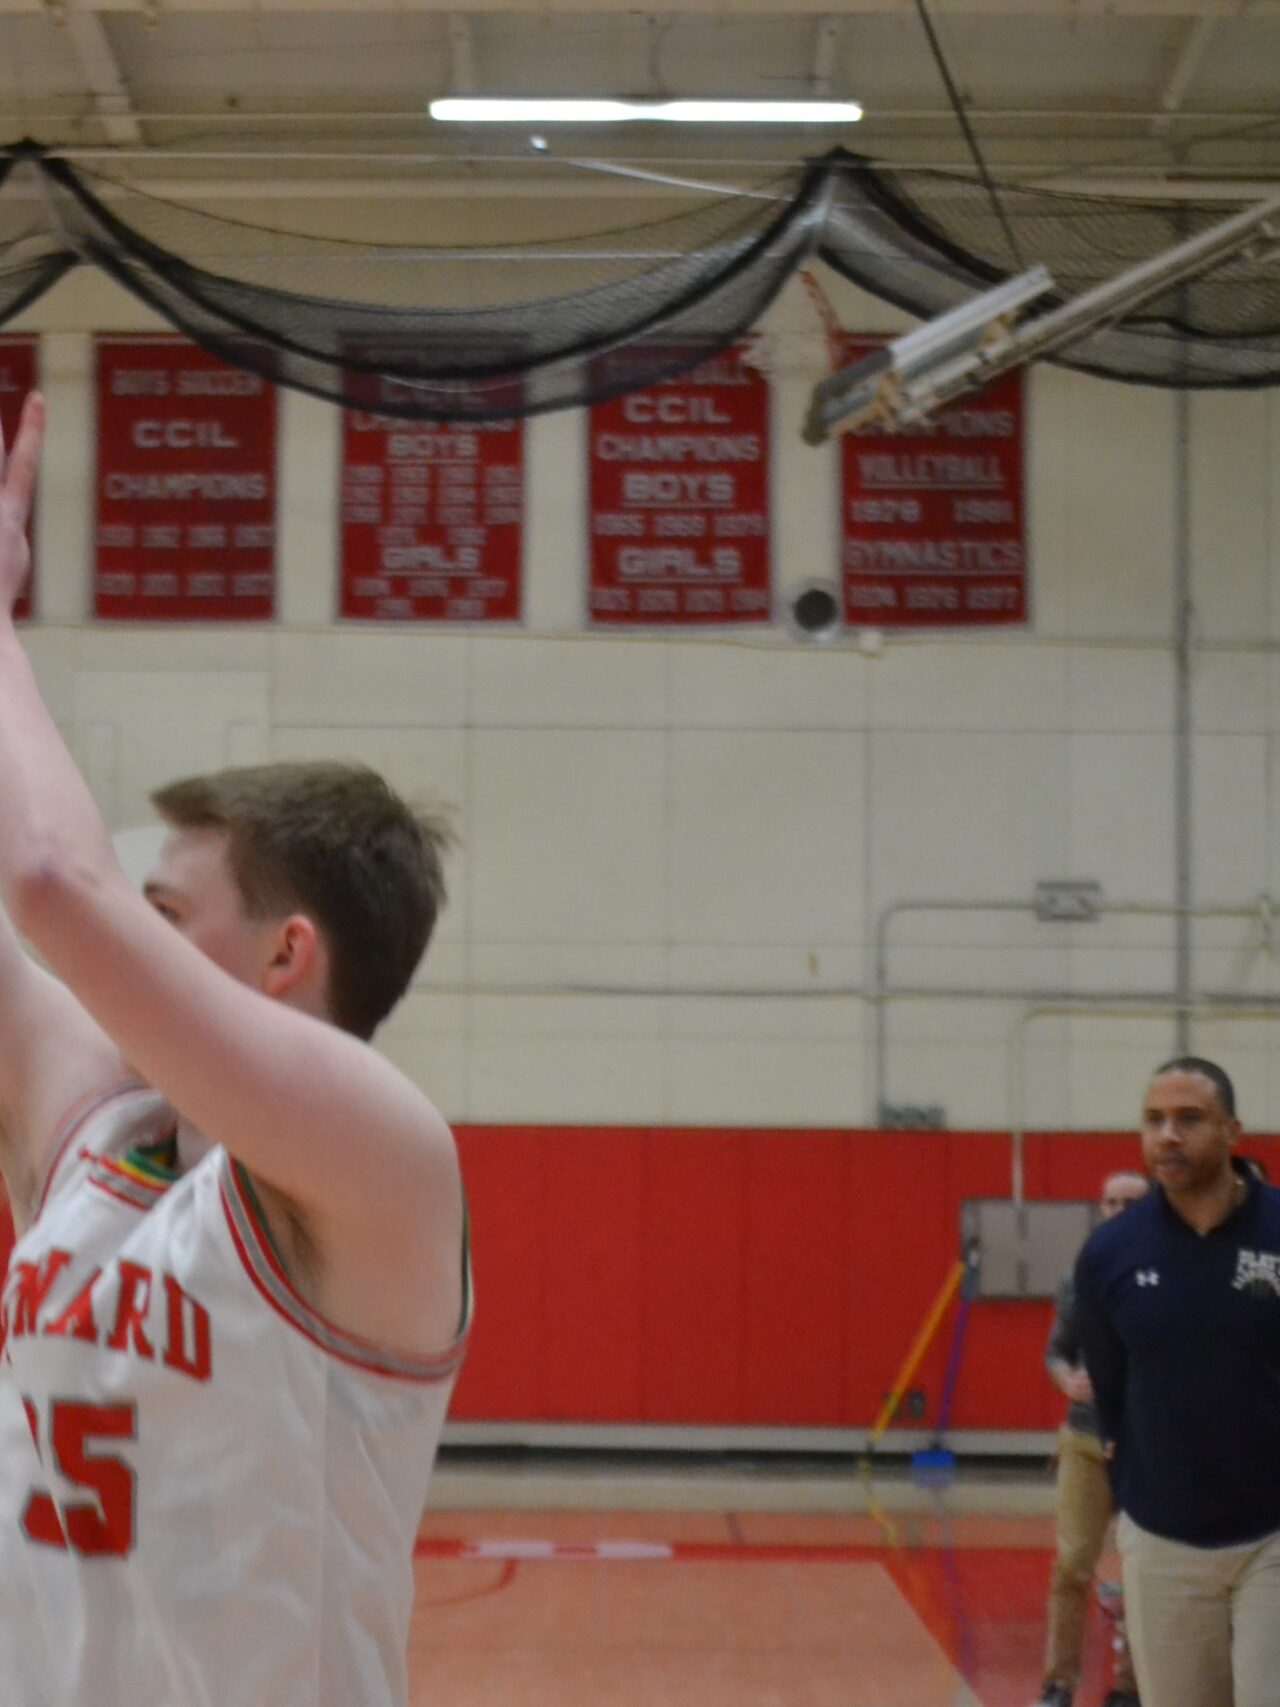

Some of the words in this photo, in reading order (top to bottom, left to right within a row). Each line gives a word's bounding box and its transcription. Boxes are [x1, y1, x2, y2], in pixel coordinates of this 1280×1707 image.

[624, 395, 732, 423] CCIL
[133, 420, 239, 448] CCIL
[387, 434, 478, 457] BOYS
[597, 433, 760, 461] CHAMPIONS
[105, 473, 267, 500] CHAMPIONS
[623, 473, 735, 500] BOYS
[619, 547, 742, 575] GIRLS
[3, 1248, 213, 1383] NARD
[22, 1395, 137, 1558] 5
